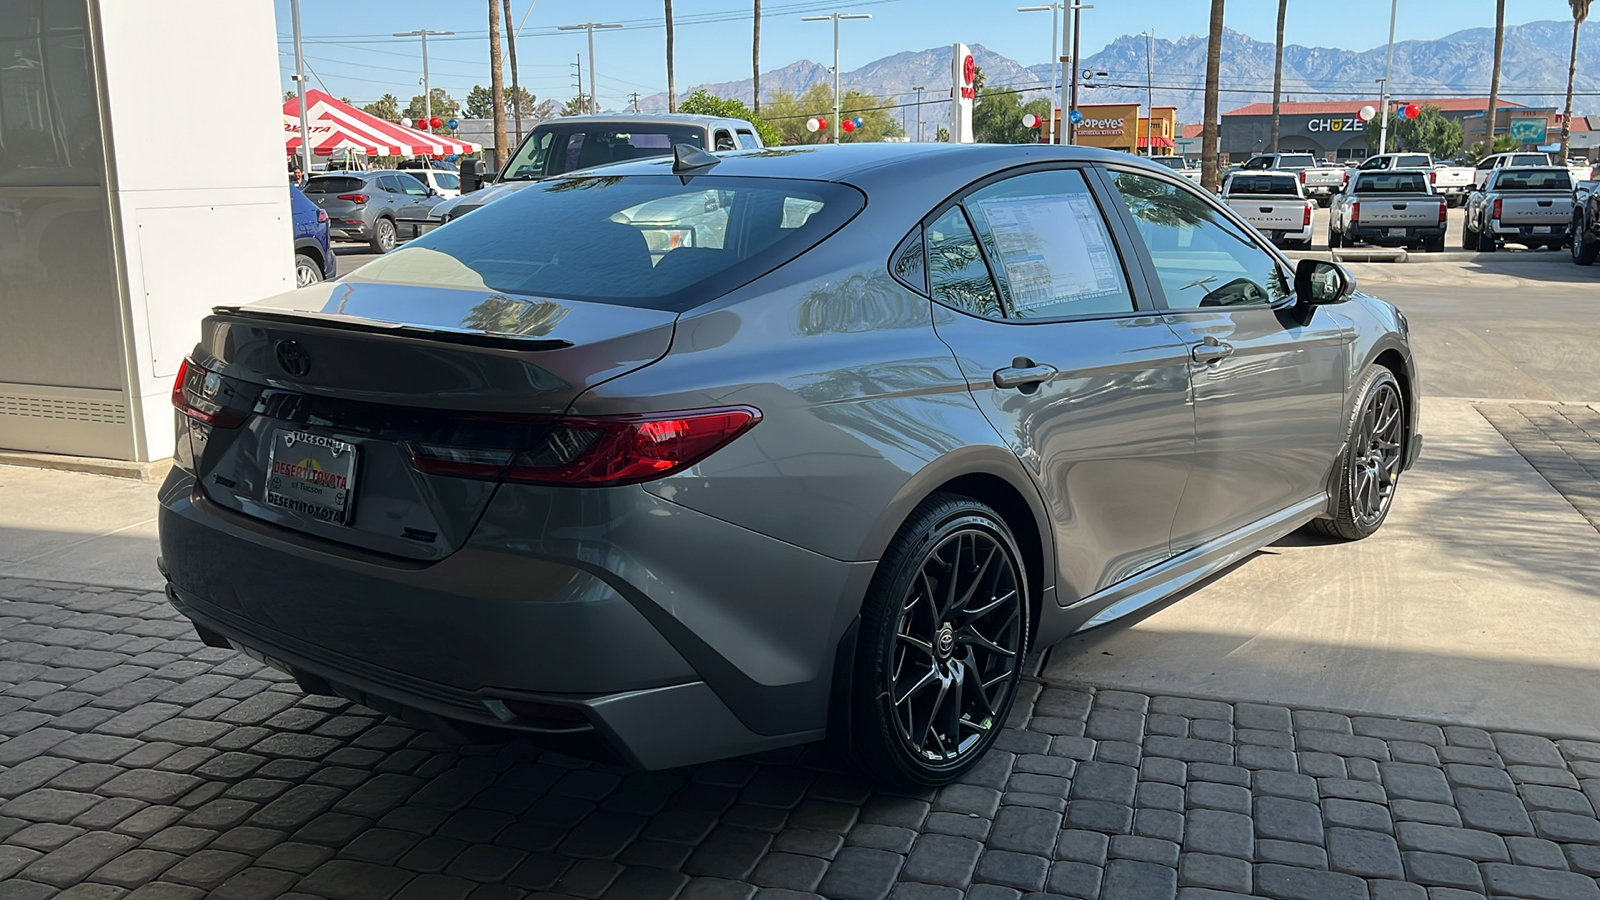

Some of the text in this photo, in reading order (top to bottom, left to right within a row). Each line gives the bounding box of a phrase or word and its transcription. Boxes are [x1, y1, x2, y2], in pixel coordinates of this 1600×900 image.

[1308, 119, 1363, 132] CHUZE
[293, 432, 333, 447] TUCSON
[273, 461, 347, 490] DESERT TOYOTA
[300, 482, 323, 495] Tucson
[268, 492, 341, 522] DESERT TOYOTA
